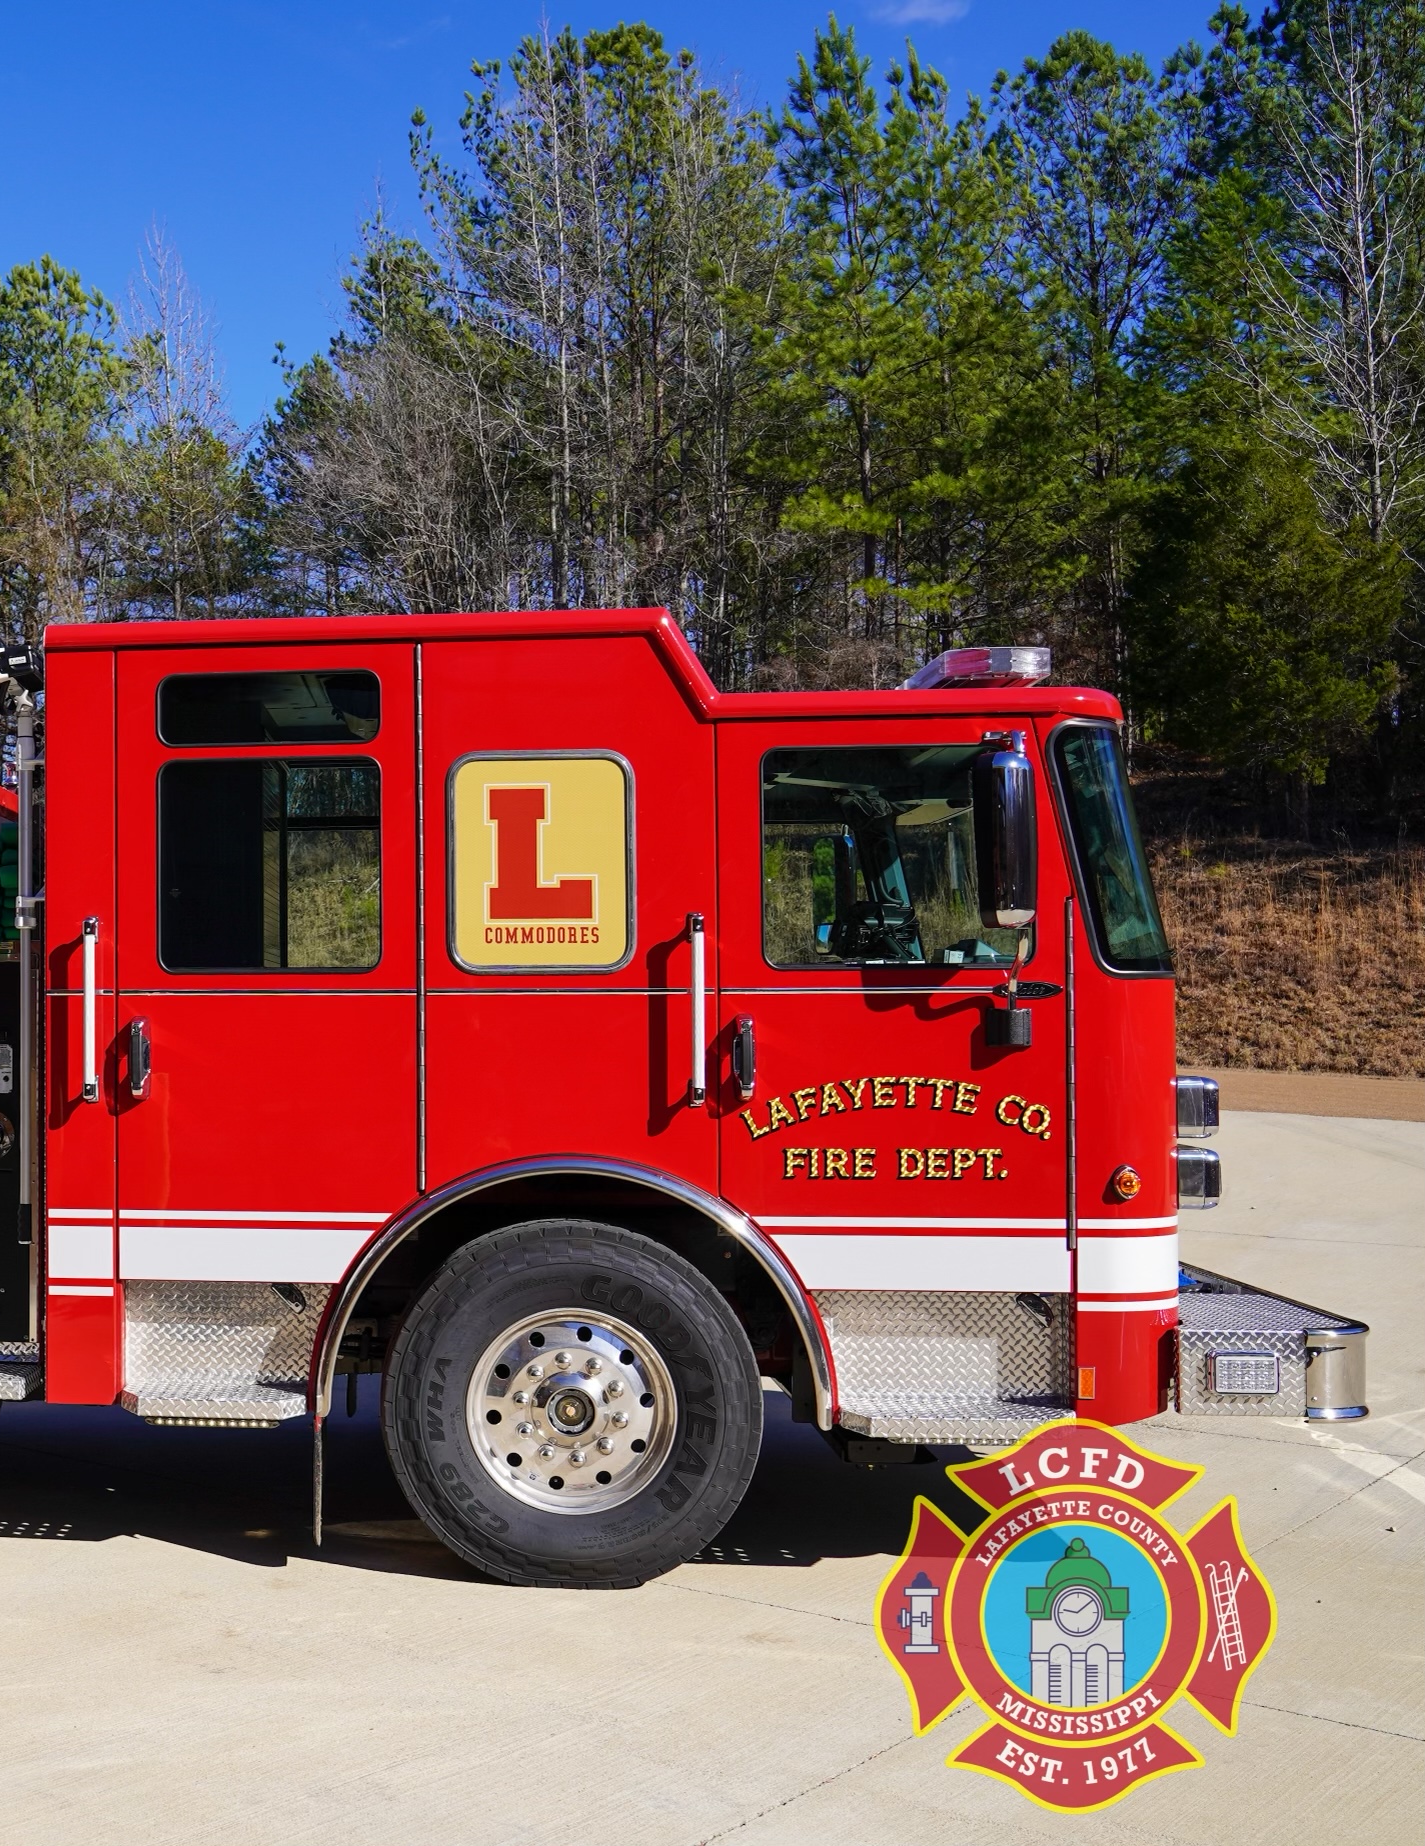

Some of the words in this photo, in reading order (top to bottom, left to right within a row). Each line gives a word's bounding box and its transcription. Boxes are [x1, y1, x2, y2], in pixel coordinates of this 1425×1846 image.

[482, 781, 599, 925] L
[484, 926, 600, 945] COMMODORES
[738, 1076, 982, 1141] LAFAYETTE
[995, 1094, 1053, 1141] CO.
[782, 1147, 878, 1181] FIRE
[896, 1147, 1009, 1181] DEPT.
[426, 1357, 453, 1443] WHA
[580, 1273, 716, 1514] GOODYEAR
[439, 1461, 510, 1534] G289
